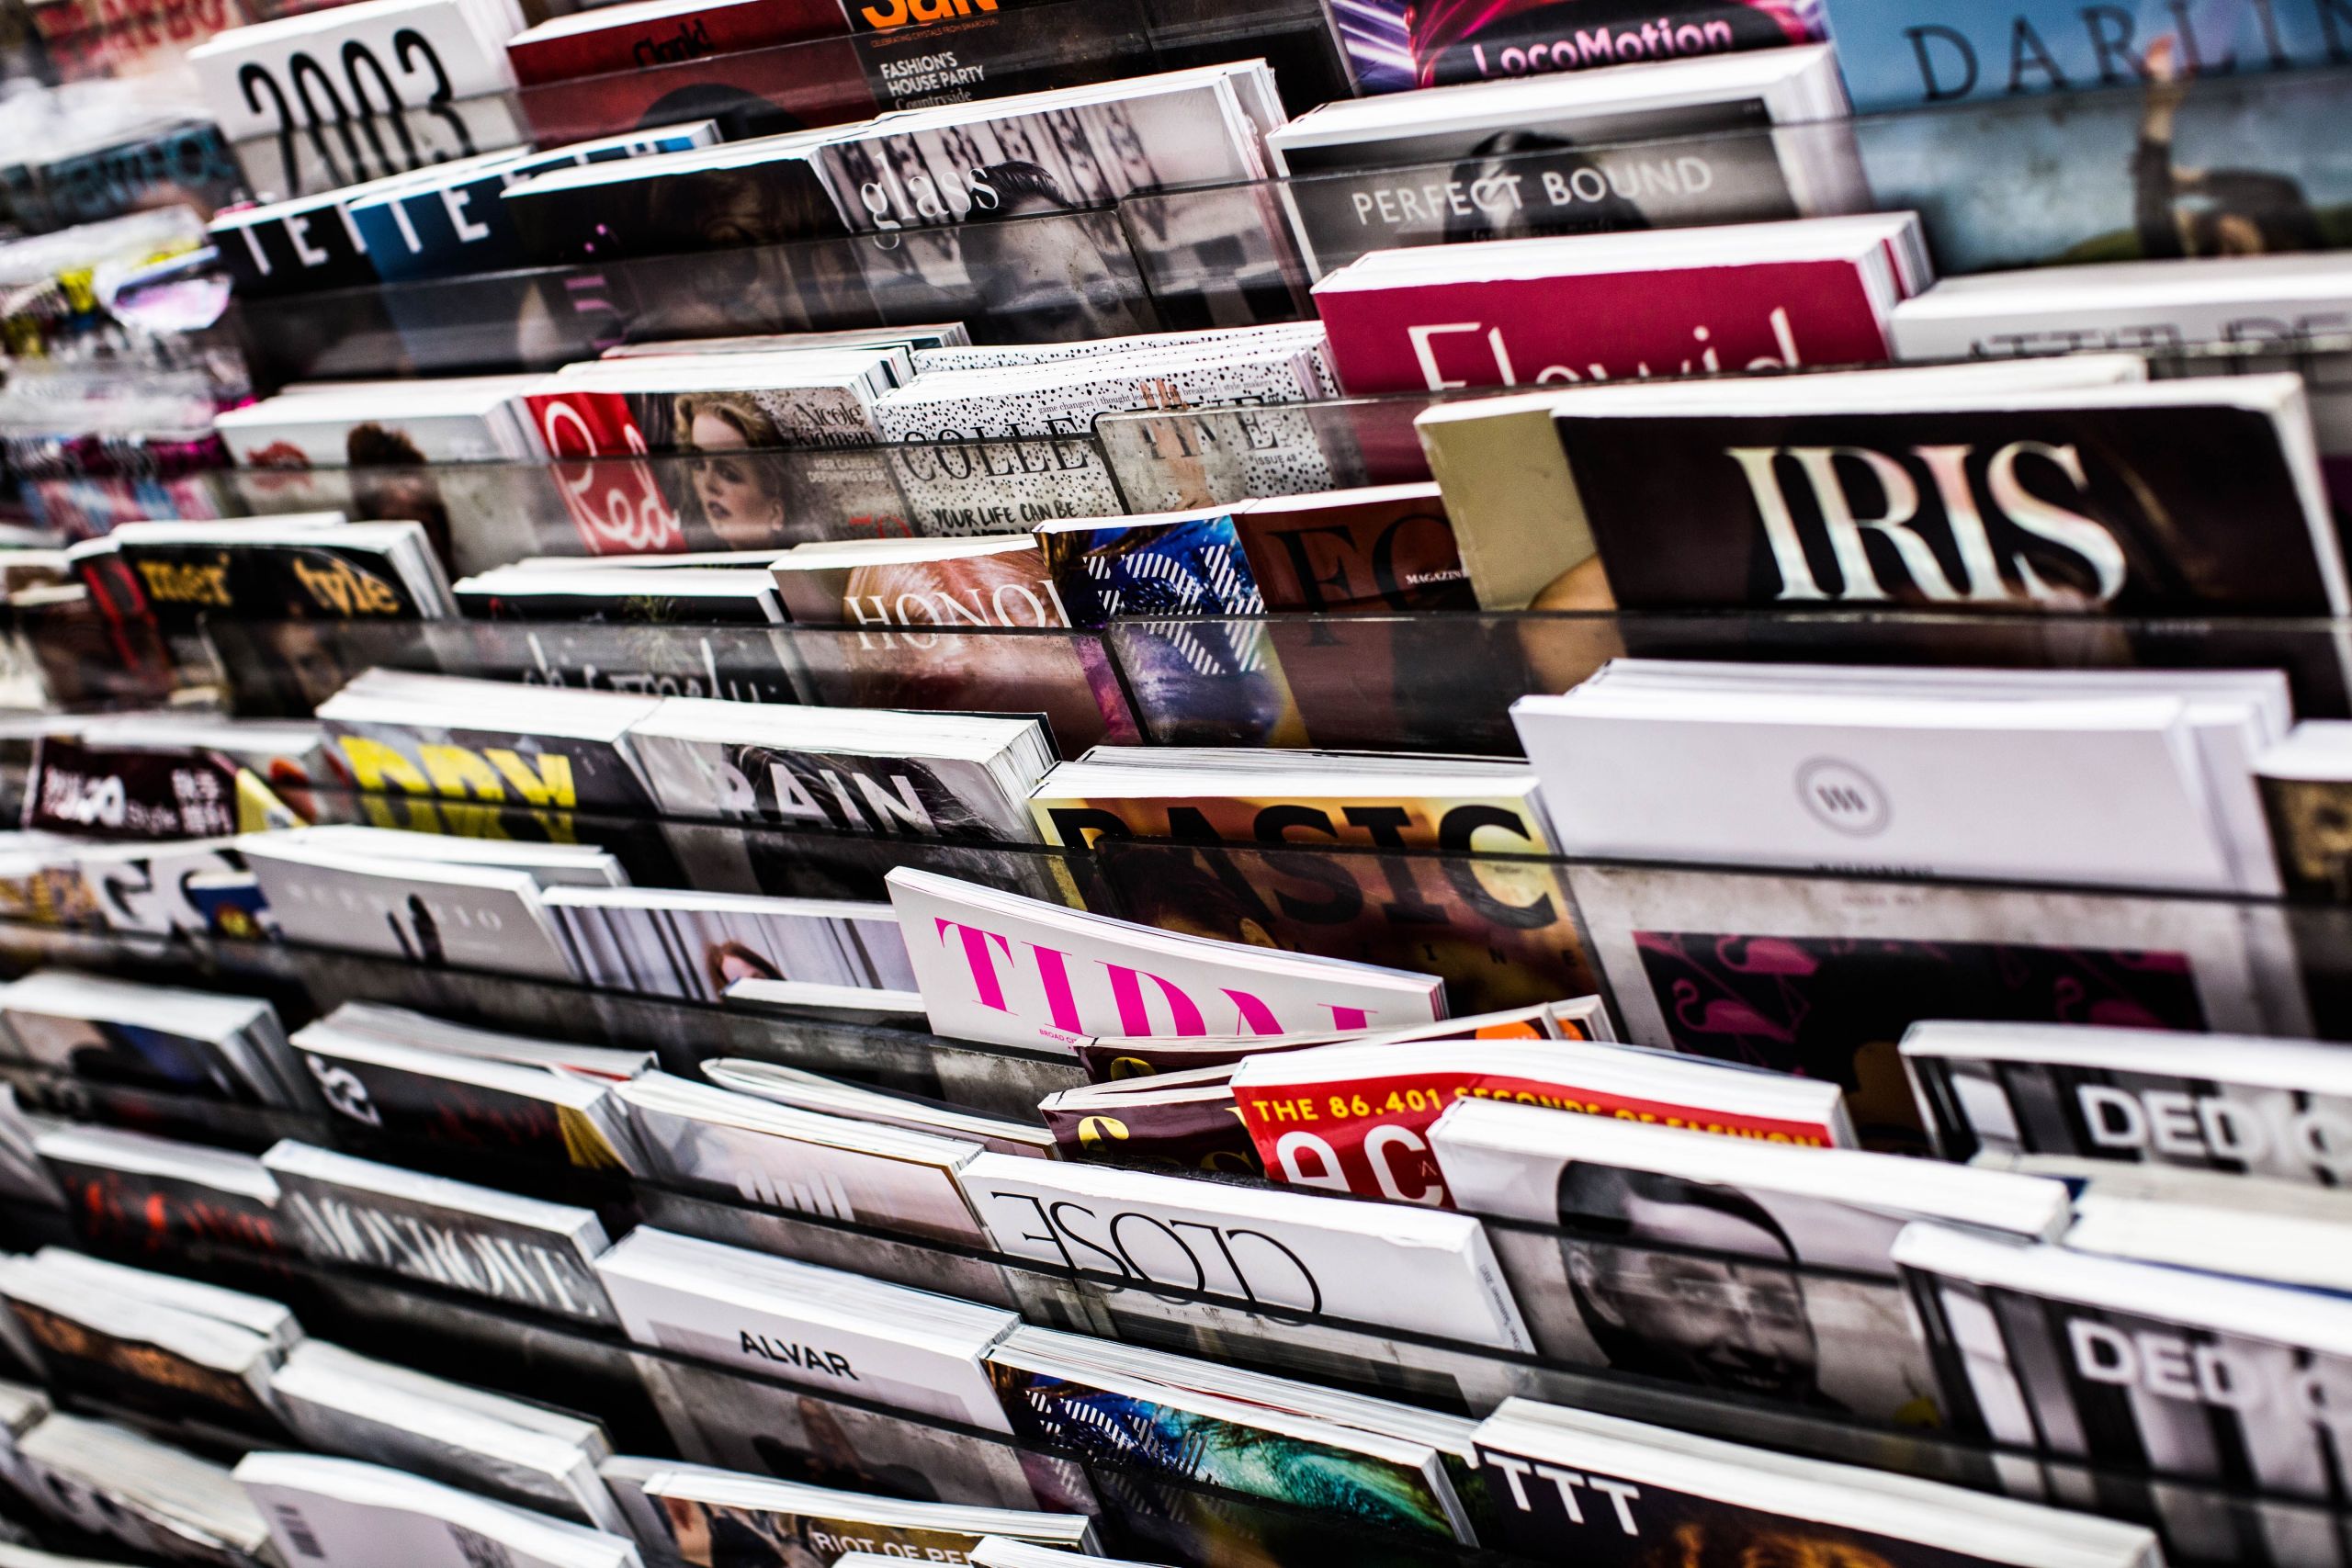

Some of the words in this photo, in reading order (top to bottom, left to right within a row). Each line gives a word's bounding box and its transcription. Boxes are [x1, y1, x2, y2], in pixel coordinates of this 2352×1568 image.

[880, 51, 958, 79] FASHION'S
[1472, 17, 1734, 79] LocoMotion
[887, 73, 941, 96] HOUSE
[938, 65, 985, 88] PARTY
[860, 152, 1000, 250] glass
[1351, 175, 1522, 225] PERFECT
[1548, 156, 1713, 207] BOUND
[796, 401, 865, 426] Nicole
[1038, 404, 1059, 415] game
[1059, 400, 1094, 412] changers
[1099, 395, 1131, 408] thought
[1132, 392, 1159, 404] leaders
[1183, 384, 1217, 398] breakers
[1223, 381, 1242, 393] style
[1243, 378, 1272, 390] makers
[544, 400, 681, 553] Red
[1254, 455, 1284, 466] ISSUE
[930, 507, 979, 530] YOUR
[978, 505, 1016, 526] LIFE
[1019, 502, 1053, 523] CAN
[1055, 500, 1080, 519] BE
[1724, 439, 2126, 604] IRIS
[1405, 569, 1463, 586] MAGAZIN
[1038, 1028, 1065, 1043] BROAD
[1251, 1099, 1320, 1123] THE
[1329, 1088, 1443, 1120] 86.401
[739, 1329, 860, 1382] ALVAR
[1484, 1450, 1641, 1537] TTT
[811, 1531, 876, 1554] RIOT
[882, 1541, 920, 1560] OF
